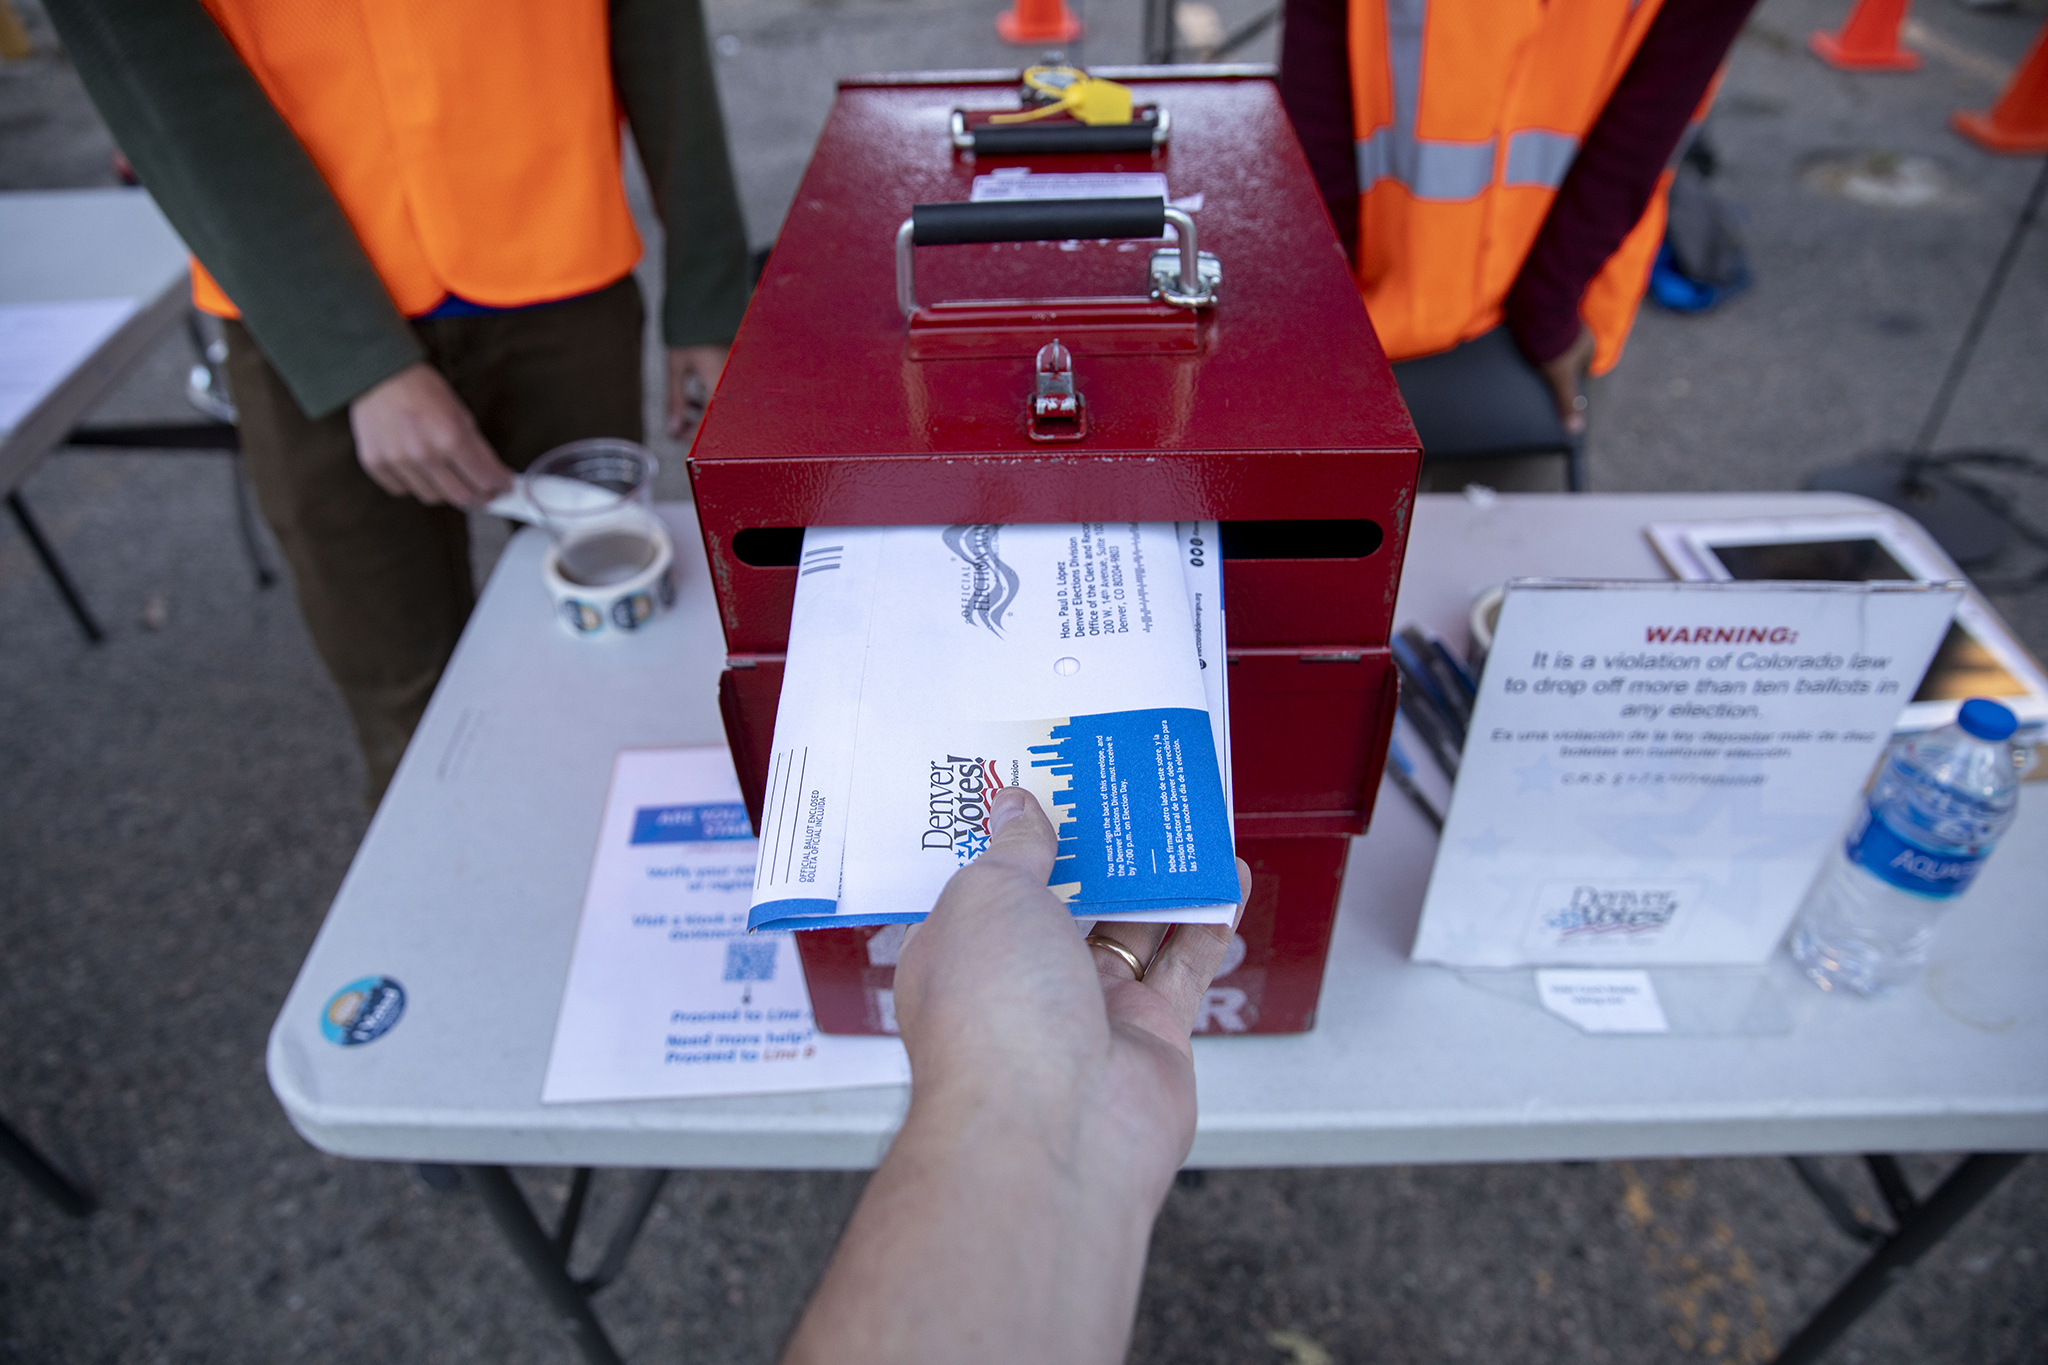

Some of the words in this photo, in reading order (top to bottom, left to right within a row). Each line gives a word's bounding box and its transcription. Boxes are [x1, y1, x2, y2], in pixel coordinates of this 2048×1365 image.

[1068, 536, 1080, 567] Division
[1083, 545, 1093, 560] and
[1096, 538, 1107, 556] Suite
[1056, 561, 1068, 586] López
[1084, 561, 1095, 582] Clerk
[1100, 557, 1110, 588] Avenue,
[1108, 545, 1124, 587] 80204-9803
[973, 552, 990, 611] ELECTION
[1071, 569, 1082, 606] Elections
[1086, 584, 1096, 598] the
[961, 566, 971, 617] OFFICIAL
[1057, 587, 1068, 596] D.
[1114, 588, 1125, 600] CO
[1058, 599, 1069, 616] Paul
[1086, 600, 1097, 609] of
[1102, 607, 1112, 618] W.
[1074, 608, 1085, 638] Denver
[1088, 610, 1100, 636] Office
[1104, 620, 1115, 634] 200
[1118, 602, 1128, 633] Denver,
[1060, 618, 1070, 639] Hon.
[1646, 626, 1799, 644] WARNING:
[1532, 651, 1548, 670] It
[1554, 652, 1574, 670] is
[1580, 655, 1596, 670] a
[1604, 652, 1700, 670] violation
[1706, 652, 1735, 671] of
[1736, 651, 1844, 672] Colorado
[1848, 652, 1893, 671] law
[1504, 676, 1528, 694] to
[1532, 676, 1587, 698] drop
[1592, 676, 1627, 695] off
[1628, 680, 1690, 695] more
[1694, 677, 1747, 696] than
[1752, 678, 1790, 696] ten
[1794, 676, 1872, 696] ballots
[1876, 677, 1900, 696] in
[1620, 703, 1665, 722] any
[1162, 720, 1170, 734] para
[1096, 735, 1104, 747] and
[1162, 734, 1172, 760] recibirlo
[1098, 748, 1106, 778] envelope,
[1106, 742, 1114, 766] receive
[1156, 746, 1164, 766] sobre,
[1010, 760, 1020, 786] Division
[1158, 767, 1166, 781] este
[1166, 761, 1174, 777] debe
[1178, 774, 1185, 782] de
[1100, 780, 1108, 792] this
[1120, 778, 1128, 793] Day.
[1159, 782, 1166, 791] de
[1169, 778, 1178, 802] Denver
[922, 760, 954, 851] Denver
[946, 754, 984, 840] Votes!
[1160, 792, 1168, 806] lado
[808, 790, 820, 824] ENCLOSED
[816, 796, 826, 828] INCLUIDA
[1102, 800, 1110, 816] back
[1120, 794, 1130, 820] Election
[1162, 807, 1170, 822] otro
[1172, 802, 1180, 812] de
[1182, 803, 1191, 824] noche
[1112, 806, 1122, 836] Elections
[1124, 821, 1131, 830] on
[1172, 812, 1184, 843] Electoral
[804, 825, 814, 850] BALLOT
[811, 829, 822, 854] OFICIAL
[1104, 830, 1114, 844] sign
[1126, 832, 1134, 848] p.m.
[1166, 831, 1174, 853] firmar
[1186, 832, 1194, 842] de
[1106, 844, 1114, 862] must
[1116, 838, 1124, 862] Denver
[1126, 848, 1134, 865] 7:00
[1186, 844, 1196, 860] 7:00
[799, 851, 810, 882] OFFICIAL
[806, 856, 818, 883] BOLETA
[1107, 863, 1115, 878] You
[1117, 864, 1126, 876] the
[1128, 866, 1137, 876] by
[1168, 854, 1177, 873] Debe
[1190, 861, 1198, 872] las
